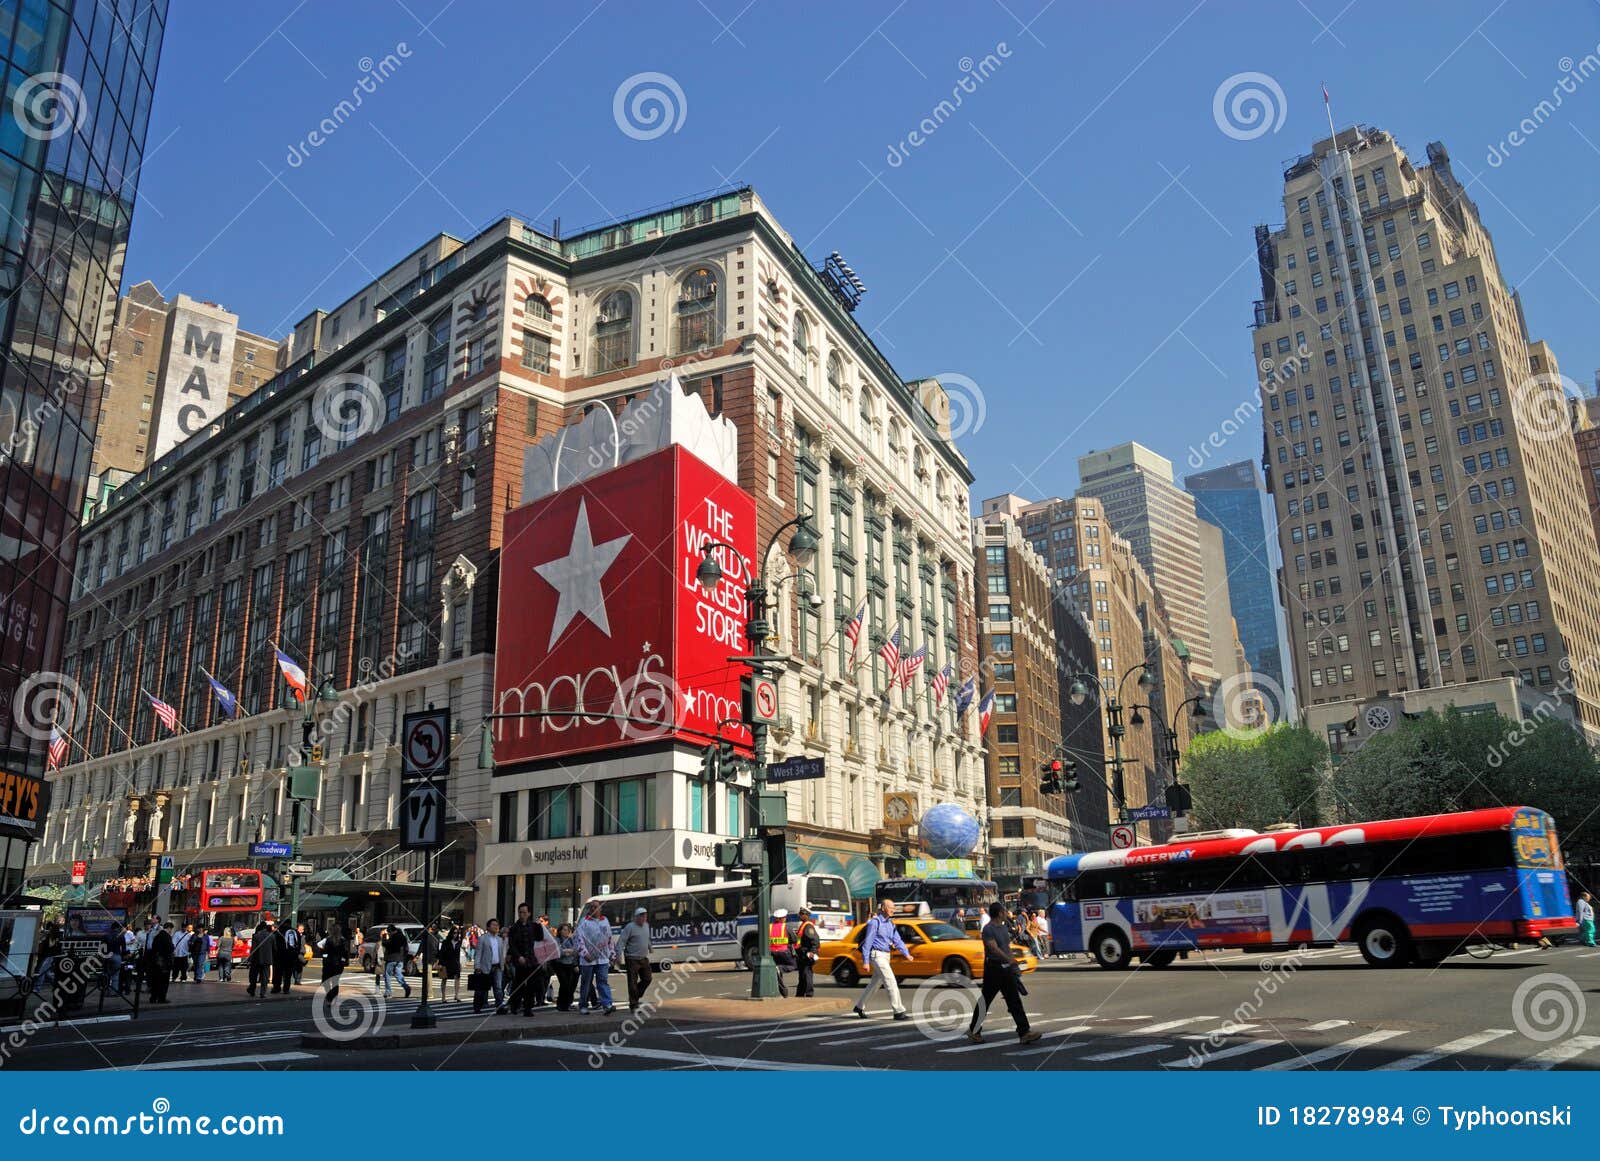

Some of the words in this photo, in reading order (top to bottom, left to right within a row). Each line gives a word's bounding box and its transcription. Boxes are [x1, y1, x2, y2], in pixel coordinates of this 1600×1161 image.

[173, 323, 224, 446] MAC
[704, 496, 734, 543] THE
[695, 600, 743, 652] STORE
[697, 688, 746, 738] mac
[773, 766, 794, 778] West
[810, 762, 820, 774] St
[254, 846, 287, 856] Broadway
[533, 847, 572, 866] sunglass
[572, 844, 589, 861] hut
[693, 841, 716, 861] sungla
[1125, 848, 1197, 866] WATERWAY
